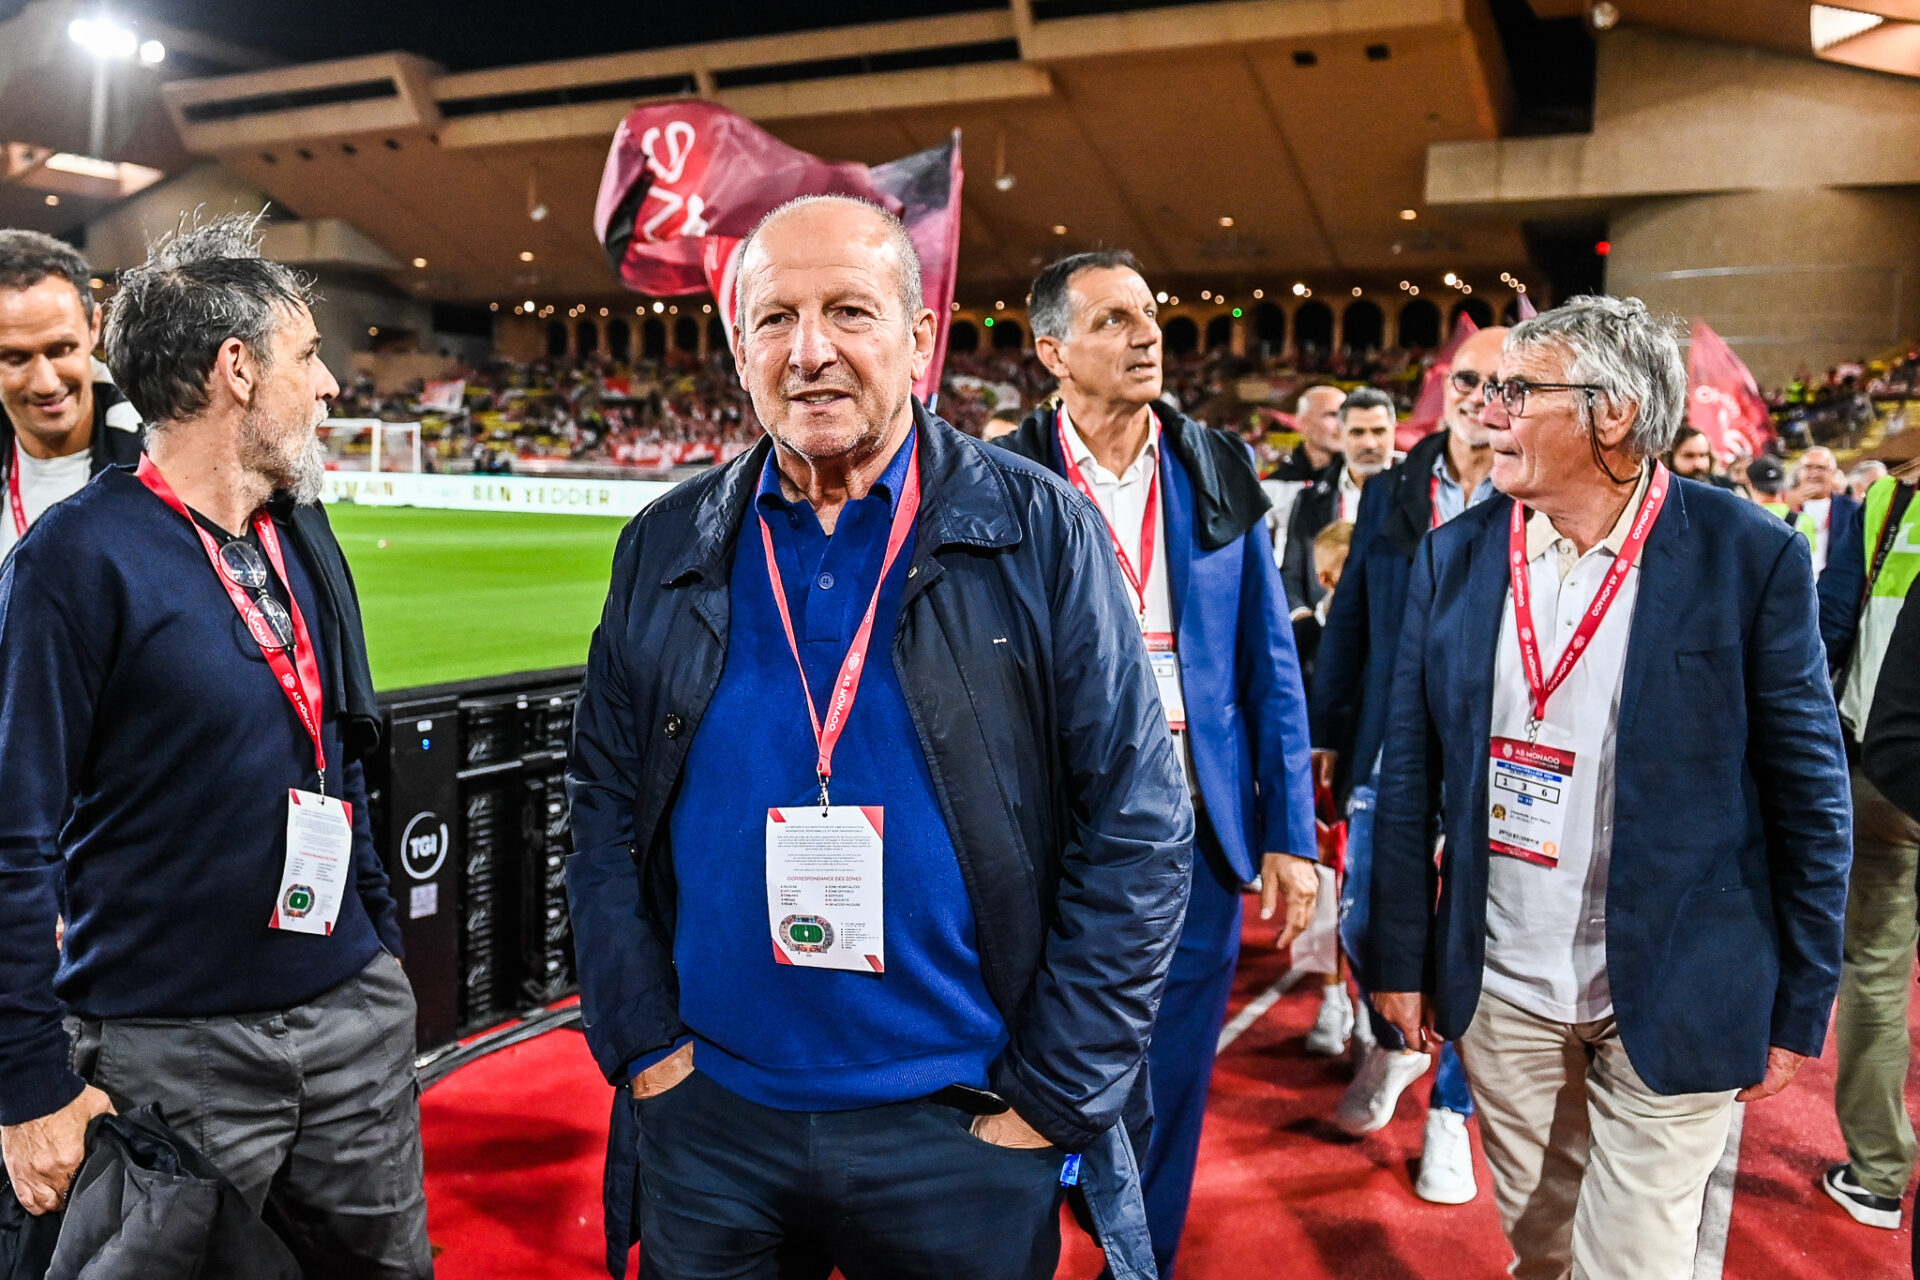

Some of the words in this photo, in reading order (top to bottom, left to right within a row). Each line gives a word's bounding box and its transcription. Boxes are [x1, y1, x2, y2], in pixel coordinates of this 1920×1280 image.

[842, 674, 852, 687] AS
[291, 691, 302, 702] AS
[298, 700, 317, 736] MONACO
[829, 689, 848, 732] MONACO
[1516, 748, 1525, 757] AS
[1526, 751, 1560, 765] MONACO
[1542, 789, 1548, 797] 6
